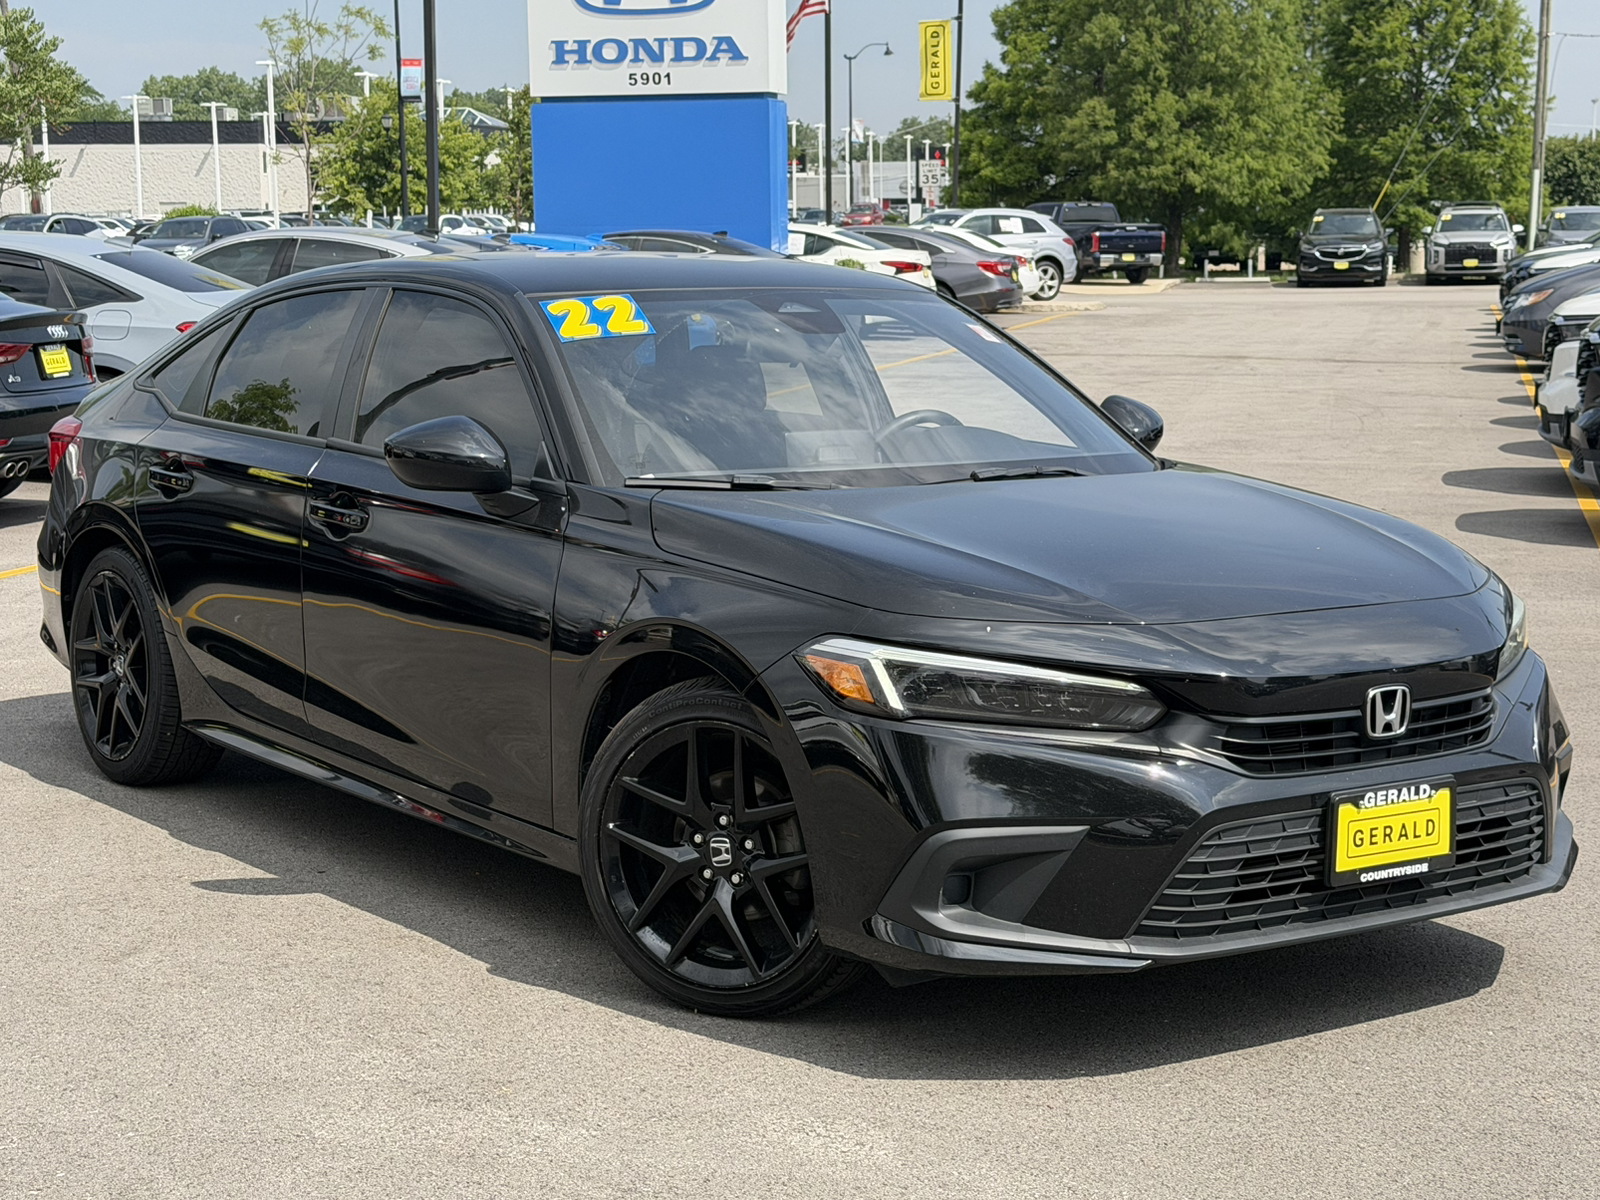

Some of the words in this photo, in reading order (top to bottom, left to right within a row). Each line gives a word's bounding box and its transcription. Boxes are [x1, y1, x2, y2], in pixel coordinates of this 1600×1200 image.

[550, 36, 749, 66] HONDA
[930, 30, 941, 90] GERALD
[628, 72, 672, 86] 5901
[922, 174, 939, 184] 35
[546, 295, 649, 339] 22
[45, 357, 67, 366] GERALD
[648, 697, 743, 718] ContiProContact
[1363, 784, 1431, 808] GERALD
[1352, 818, 1436, 848] GERALD
[1359, 863, 1430, 882] COUNTRYSIDE
